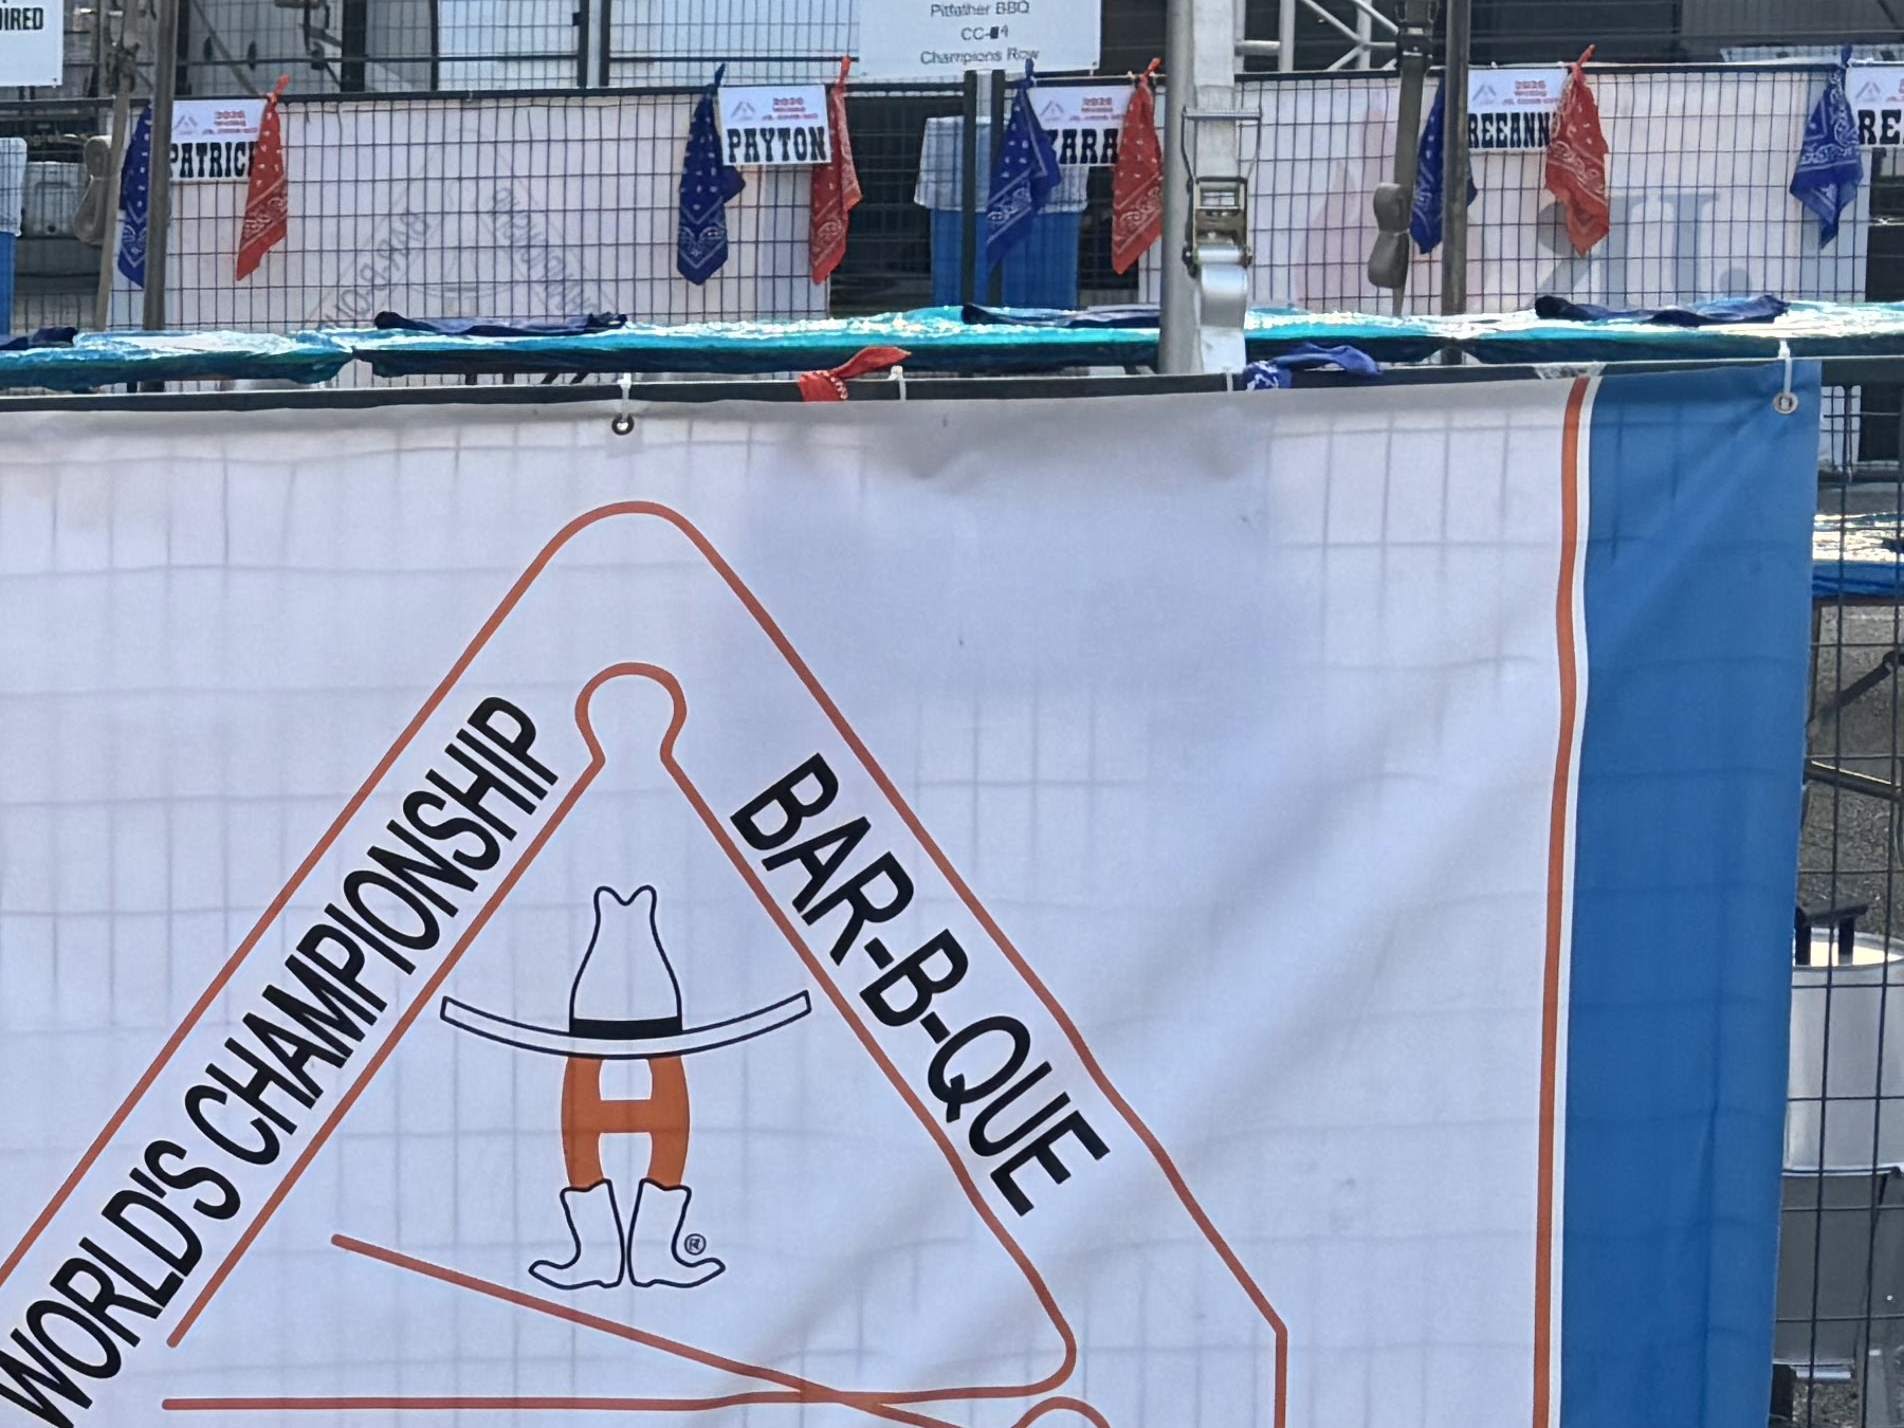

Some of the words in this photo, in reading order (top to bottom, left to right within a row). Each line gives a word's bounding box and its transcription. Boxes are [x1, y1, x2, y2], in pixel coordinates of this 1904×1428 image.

[995, 0, 1030, 15] BBQ
[920, 48, 1003, 65] Champions
[1006, 47, 1040, 61] Row
[726, 125, 828, 164] PAYTON
[1468, 111, 1558, 149] REEANN
[185, 698, 557, 1164] CHAMPIONSHIP
[731, 754, 1109, 1215] BAR-B-QUE
